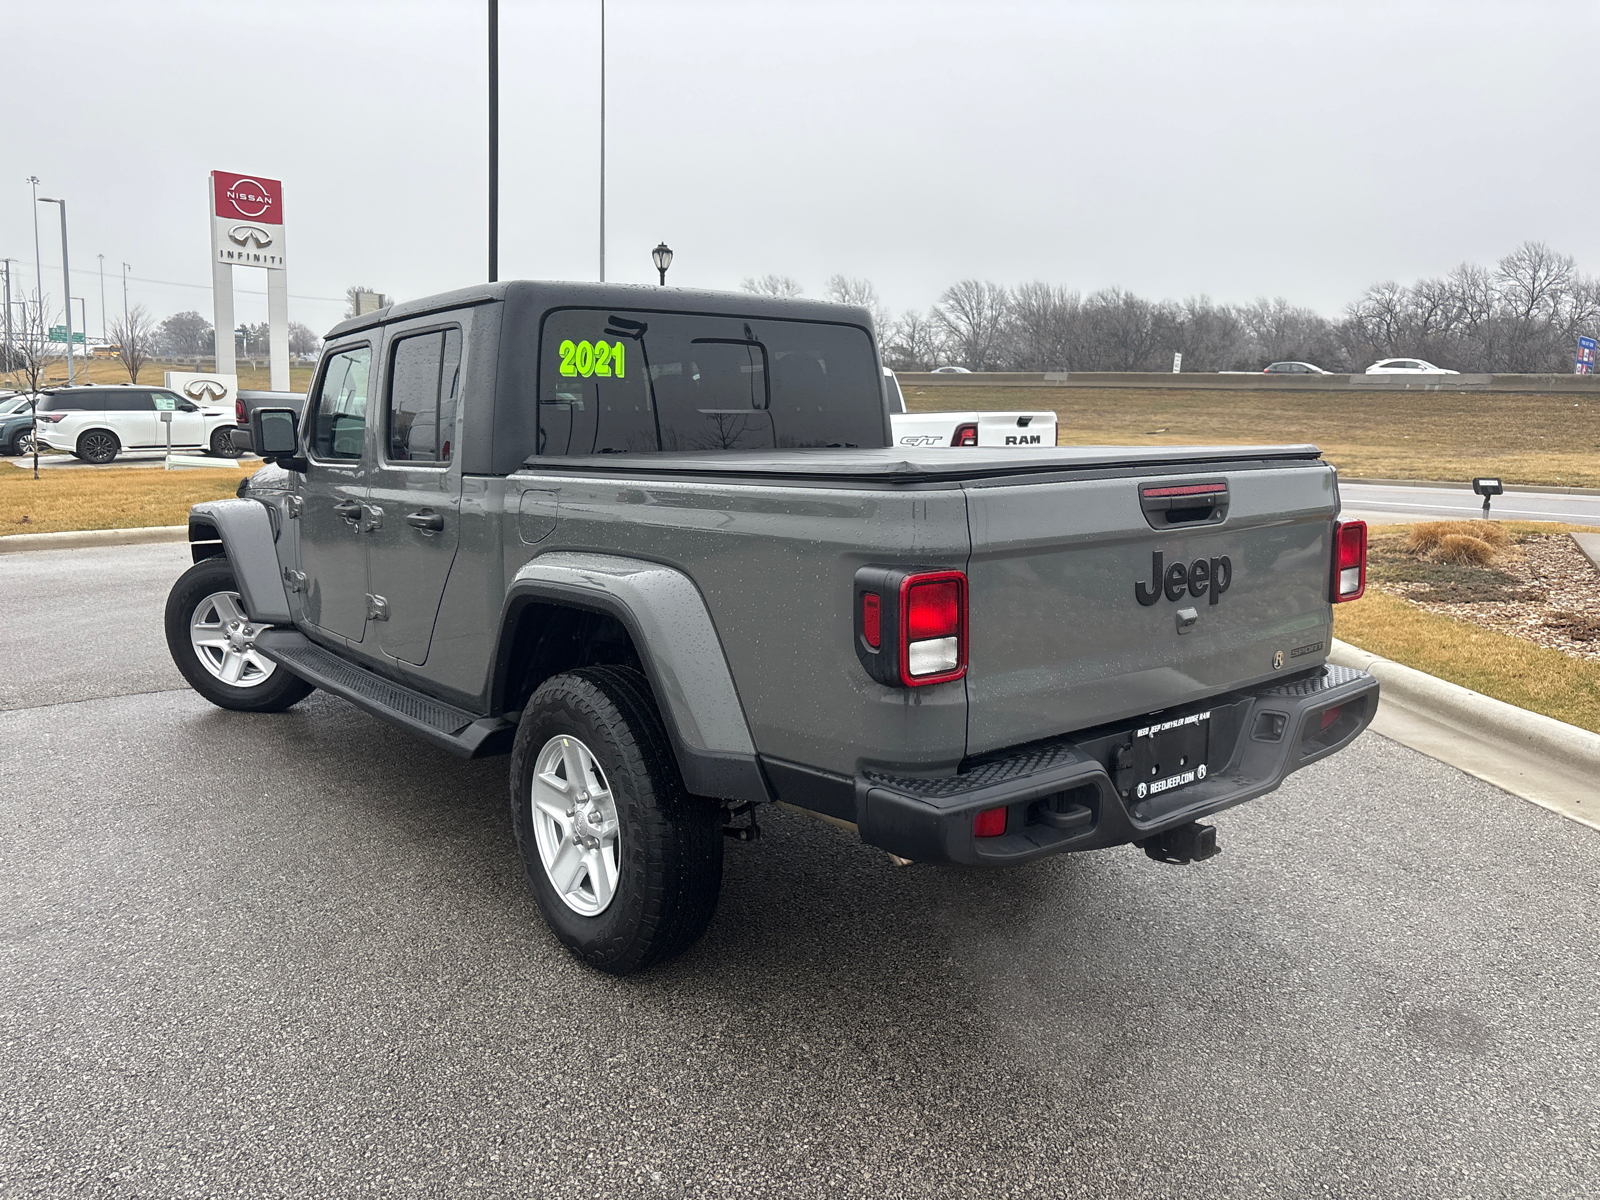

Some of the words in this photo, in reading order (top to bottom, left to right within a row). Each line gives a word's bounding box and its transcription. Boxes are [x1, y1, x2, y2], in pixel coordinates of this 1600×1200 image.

[227, 191, 272, 204] NISSAN
[220, 249, 283, 265] INFINITI
[559, 339, 625, 378] 2021
[1005, 435, 1041, 446] RAM
[1135, 549, 1232, 606] Jeep
[1291, 641, 1323, 657] SPORT
[1161, 718, 1184, 731] CHRYSLER
[1184, 714, 1199, 725] DODGE
[1199, 711, 1211, 721] RAM
[1150, 771, 1195, 794] REEDJEEP.COM
